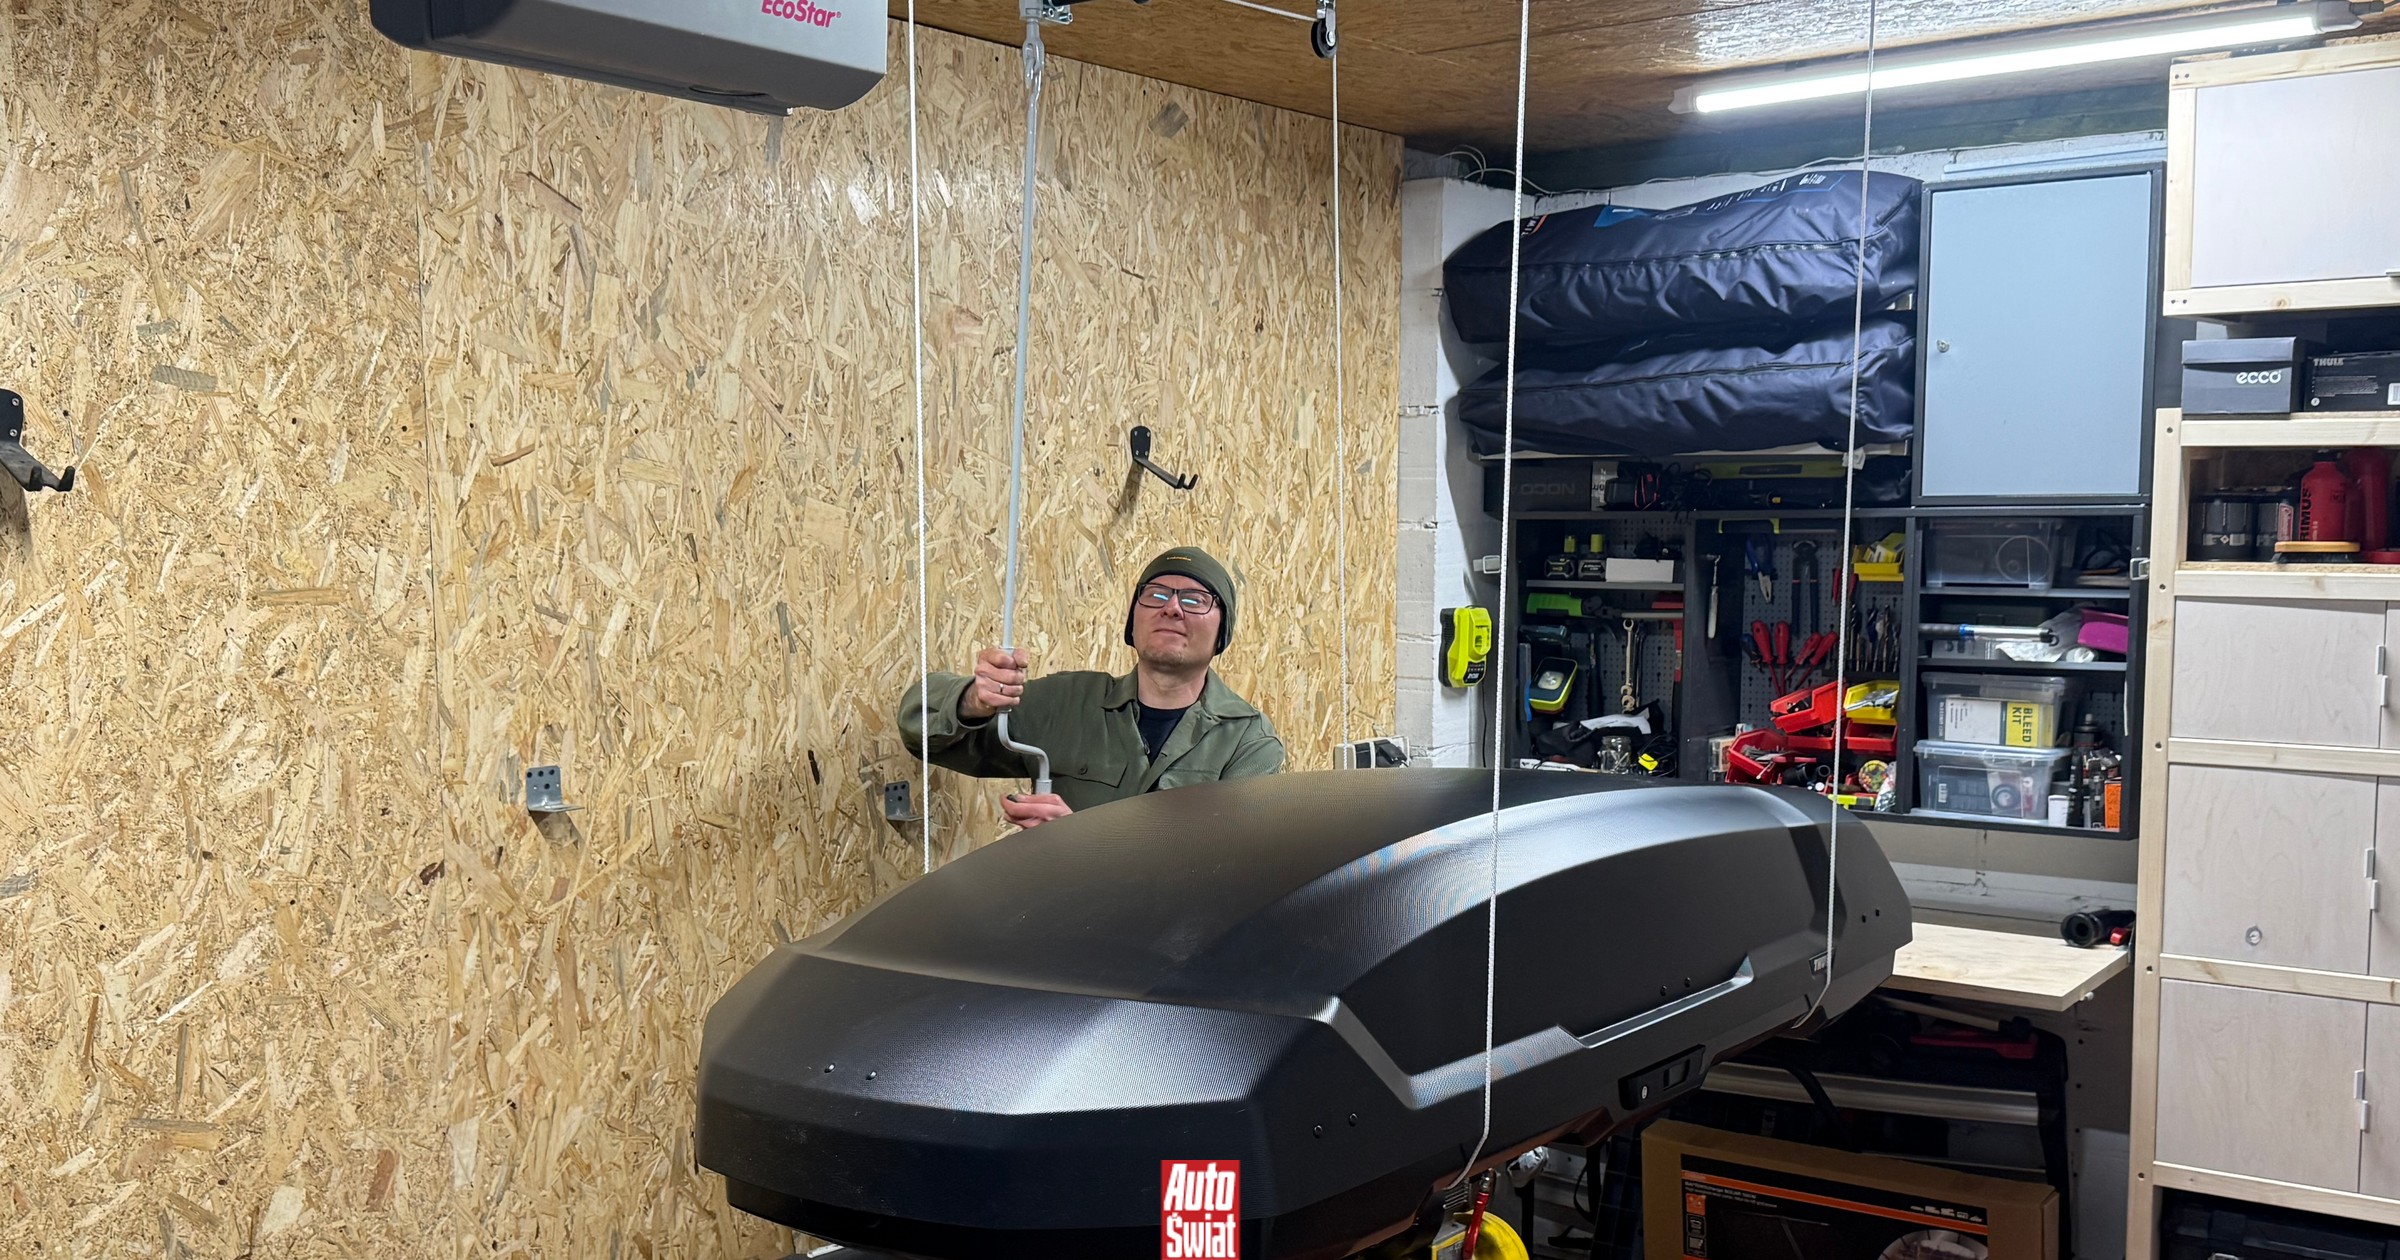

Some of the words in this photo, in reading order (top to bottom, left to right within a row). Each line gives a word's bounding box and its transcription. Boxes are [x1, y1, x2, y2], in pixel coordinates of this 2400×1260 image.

[761, 0, 836, 28] EcoStar
[2235, 371, 2282, 385] ecco
[2300, 488, 2312, 541] RIMUS
[2012, 707, 2022, 725] KIT
[2022, 707, 2033, 743] BLEED
